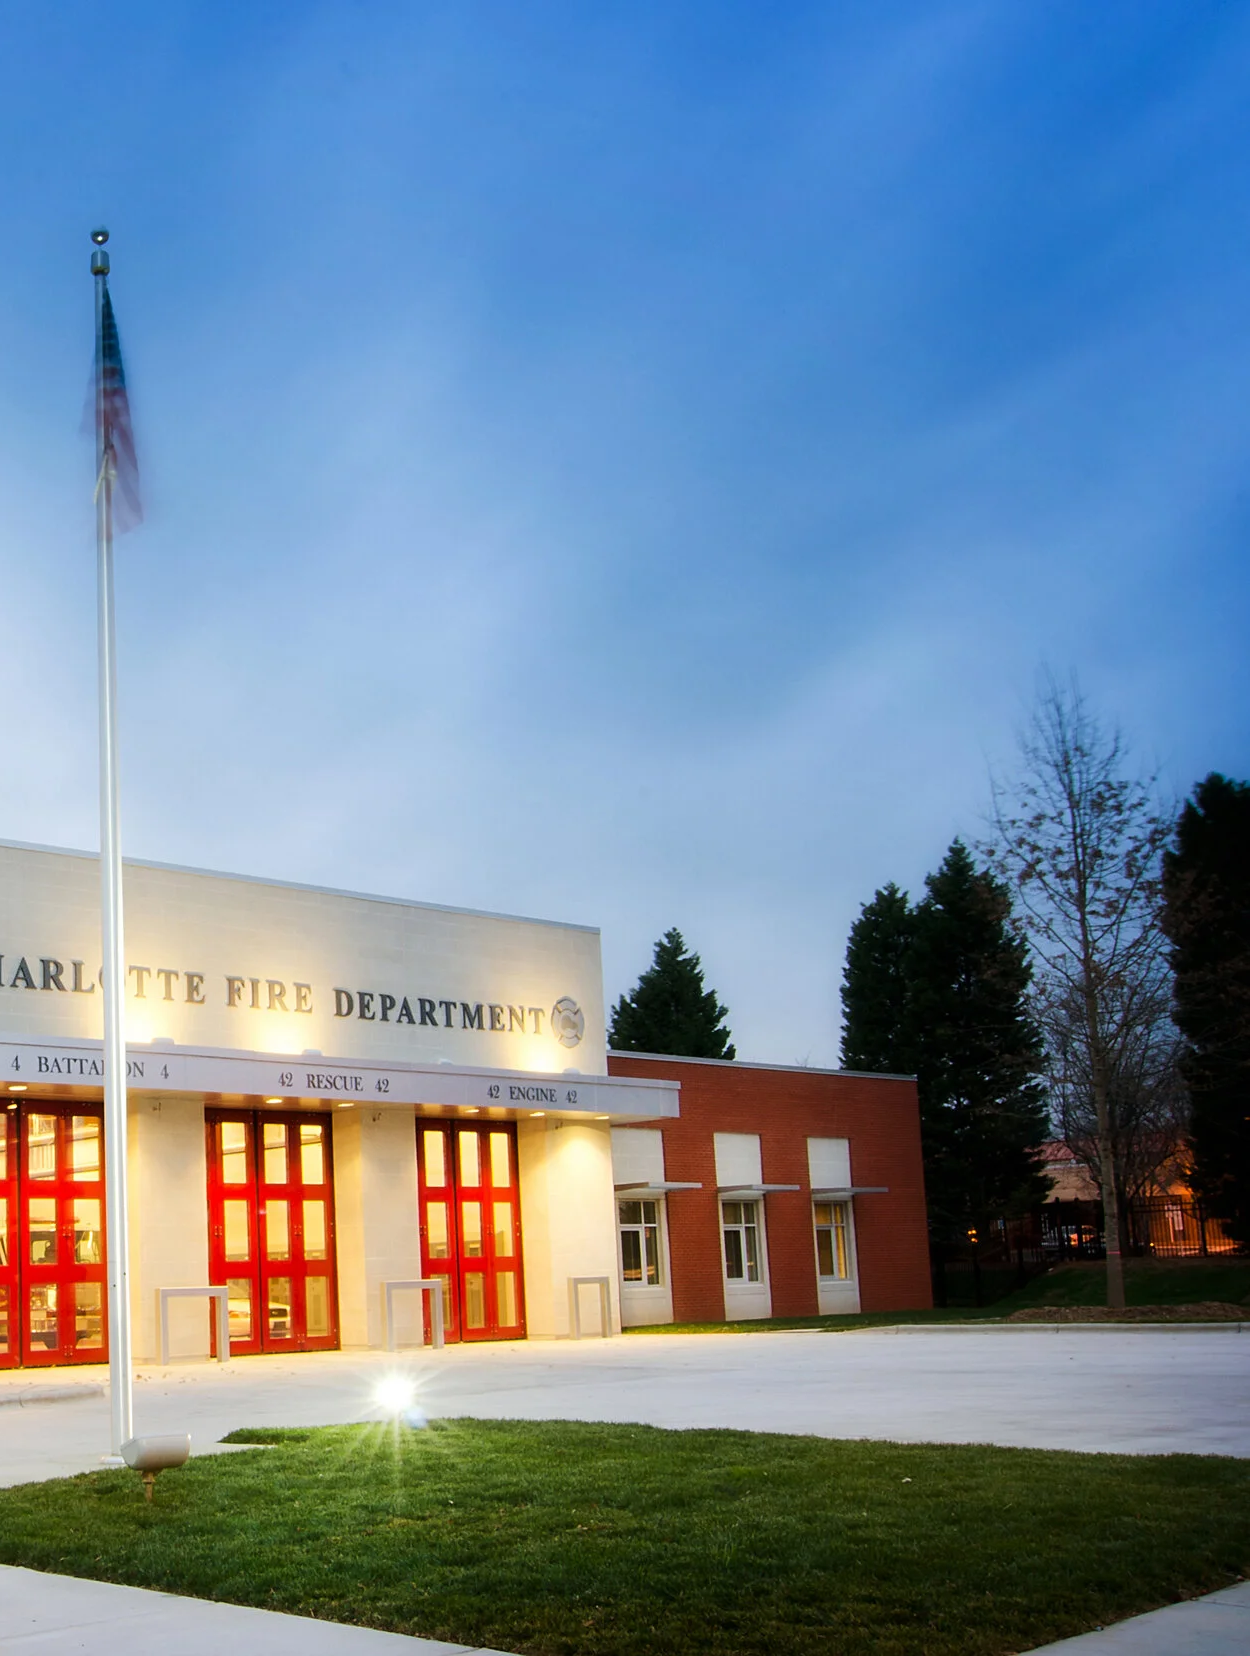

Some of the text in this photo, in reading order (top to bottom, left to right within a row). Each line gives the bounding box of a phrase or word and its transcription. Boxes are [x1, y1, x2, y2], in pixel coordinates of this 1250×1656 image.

[225, 974, 314, 1015] FIRE
[332, 986, 545, 1035] DEPARTMENT
[11, 1055, 169, 1079] 4 BATTAN 4
[278, 1071, 390, 1094] 42 RESCUE 42
[487, 1084, 578, 1104] 42 ENGINE 42
